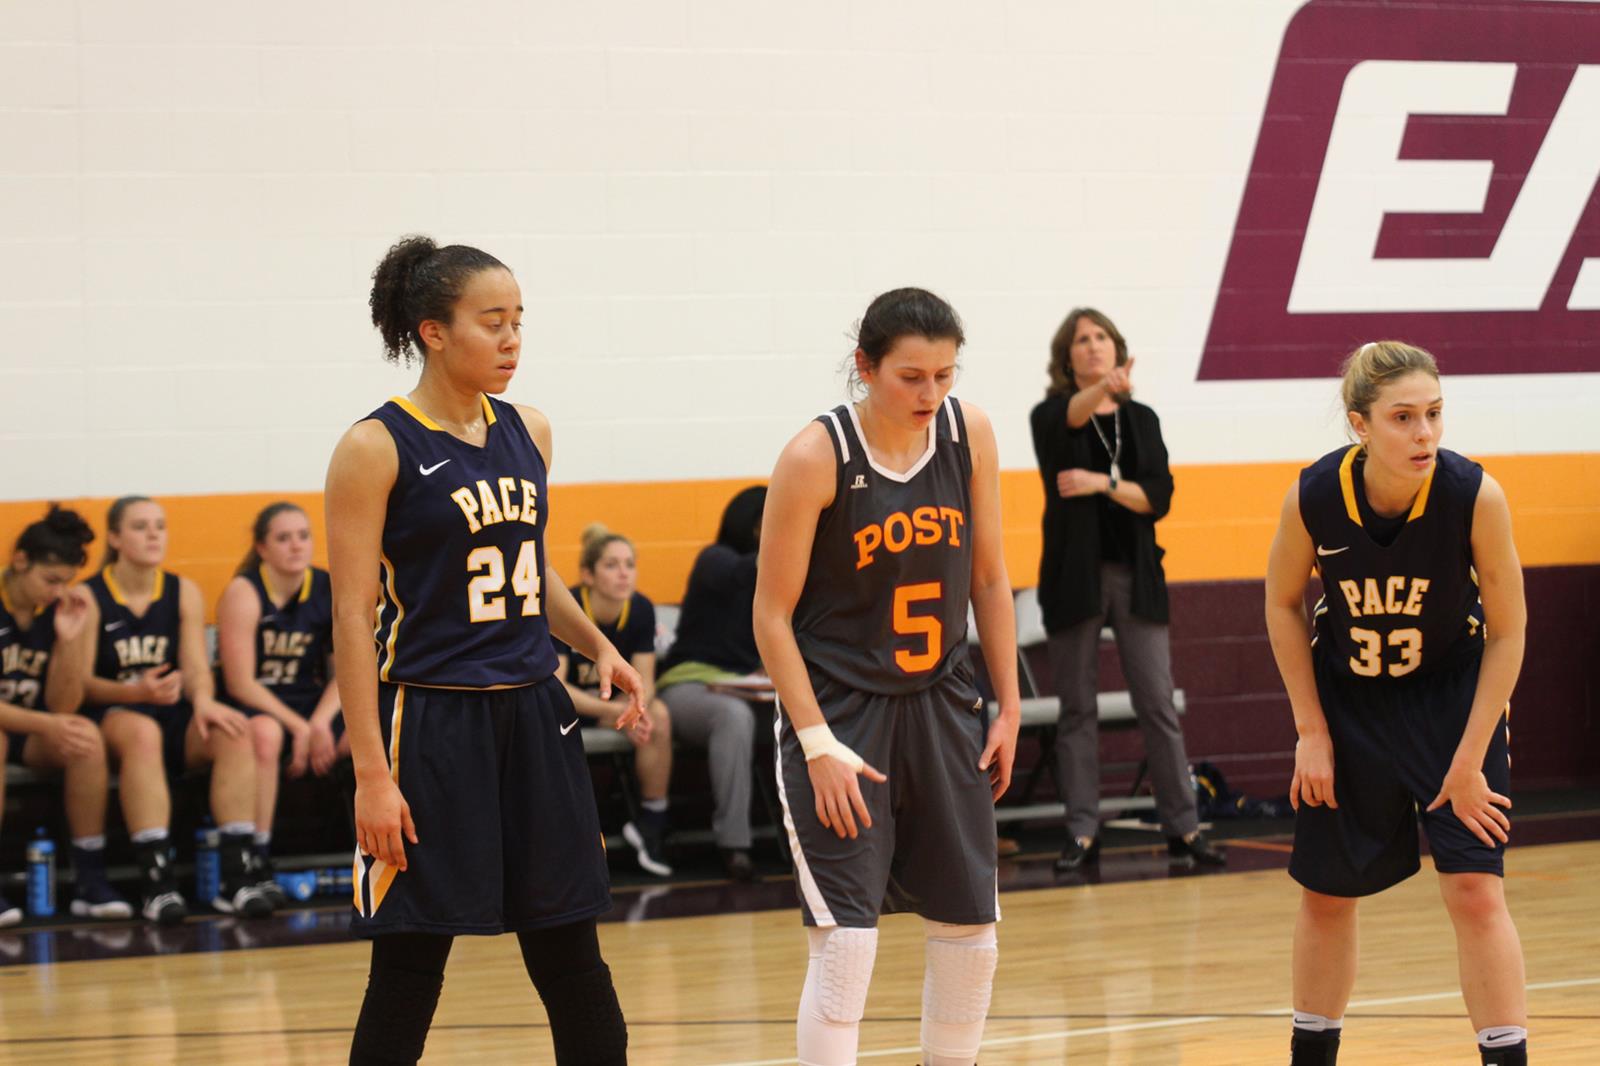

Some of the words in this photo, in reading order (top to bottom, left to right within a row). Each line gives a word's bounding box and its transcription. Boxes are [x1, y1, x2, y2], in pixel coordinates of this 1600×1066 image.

[450, 477, 538, 534] PACE
[853, 506, 964, 570] POST
[467, 540, 541, 623] 24
[1338, 576, 1431, 617] PACE
[114, 635, 169, 667] PACE
[893, 581, 942, 673] 5
[1350, 626, 1422, 677] 33
